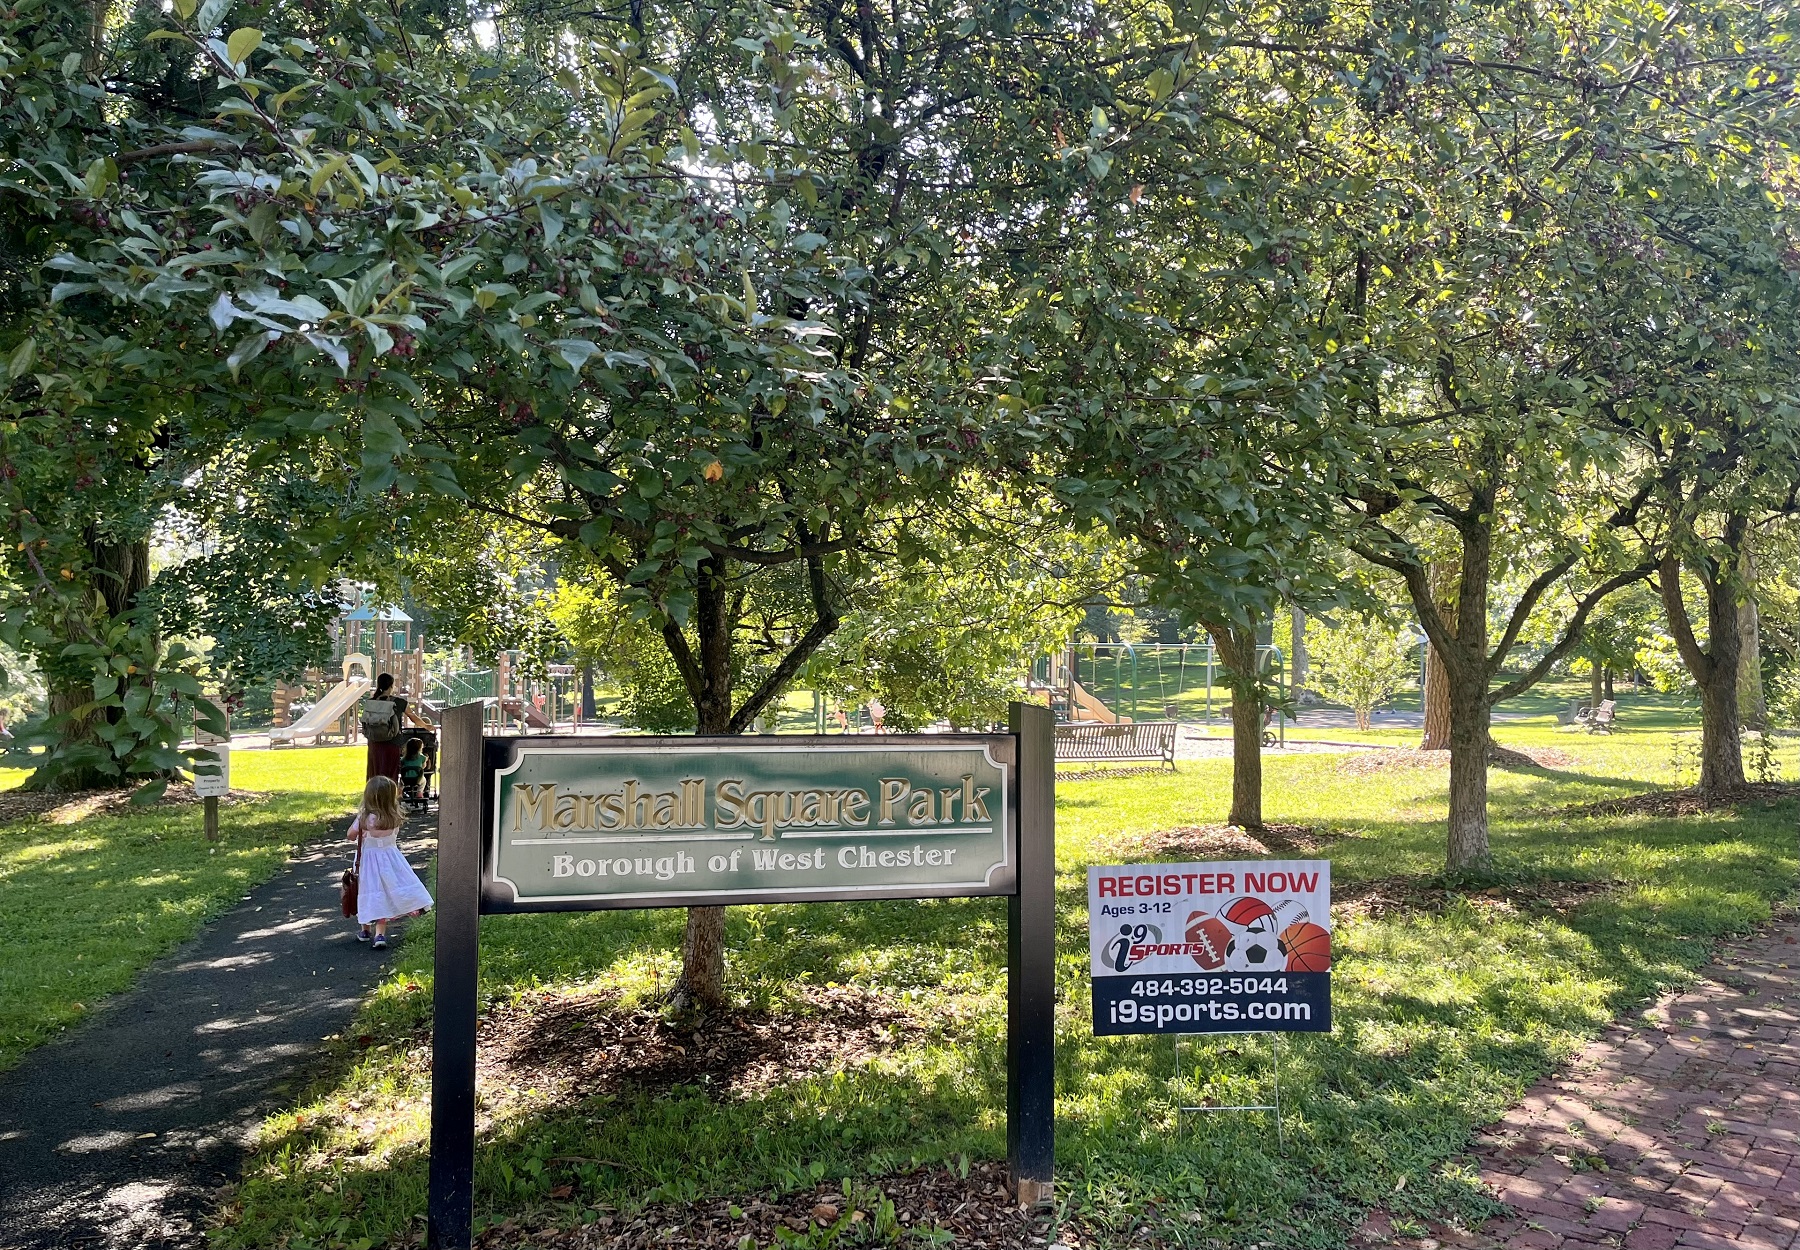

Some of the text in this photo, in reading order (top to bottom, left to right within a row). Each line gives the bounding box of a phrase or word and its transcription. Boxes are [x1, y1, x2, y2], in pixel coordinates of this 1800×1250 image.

[512, 774, 993, 841] Marshall Square Park
[552, 844, 957, 880] Borough of West Chester
[1098, 872, 1319, 897] REGISTER NOW
[1101, 902, 1172, 918] Ages 3-12
[1130, 977, 1289, 997] 484-392-5044
[1110, 1000, 1311, 1028] i9sports.com
